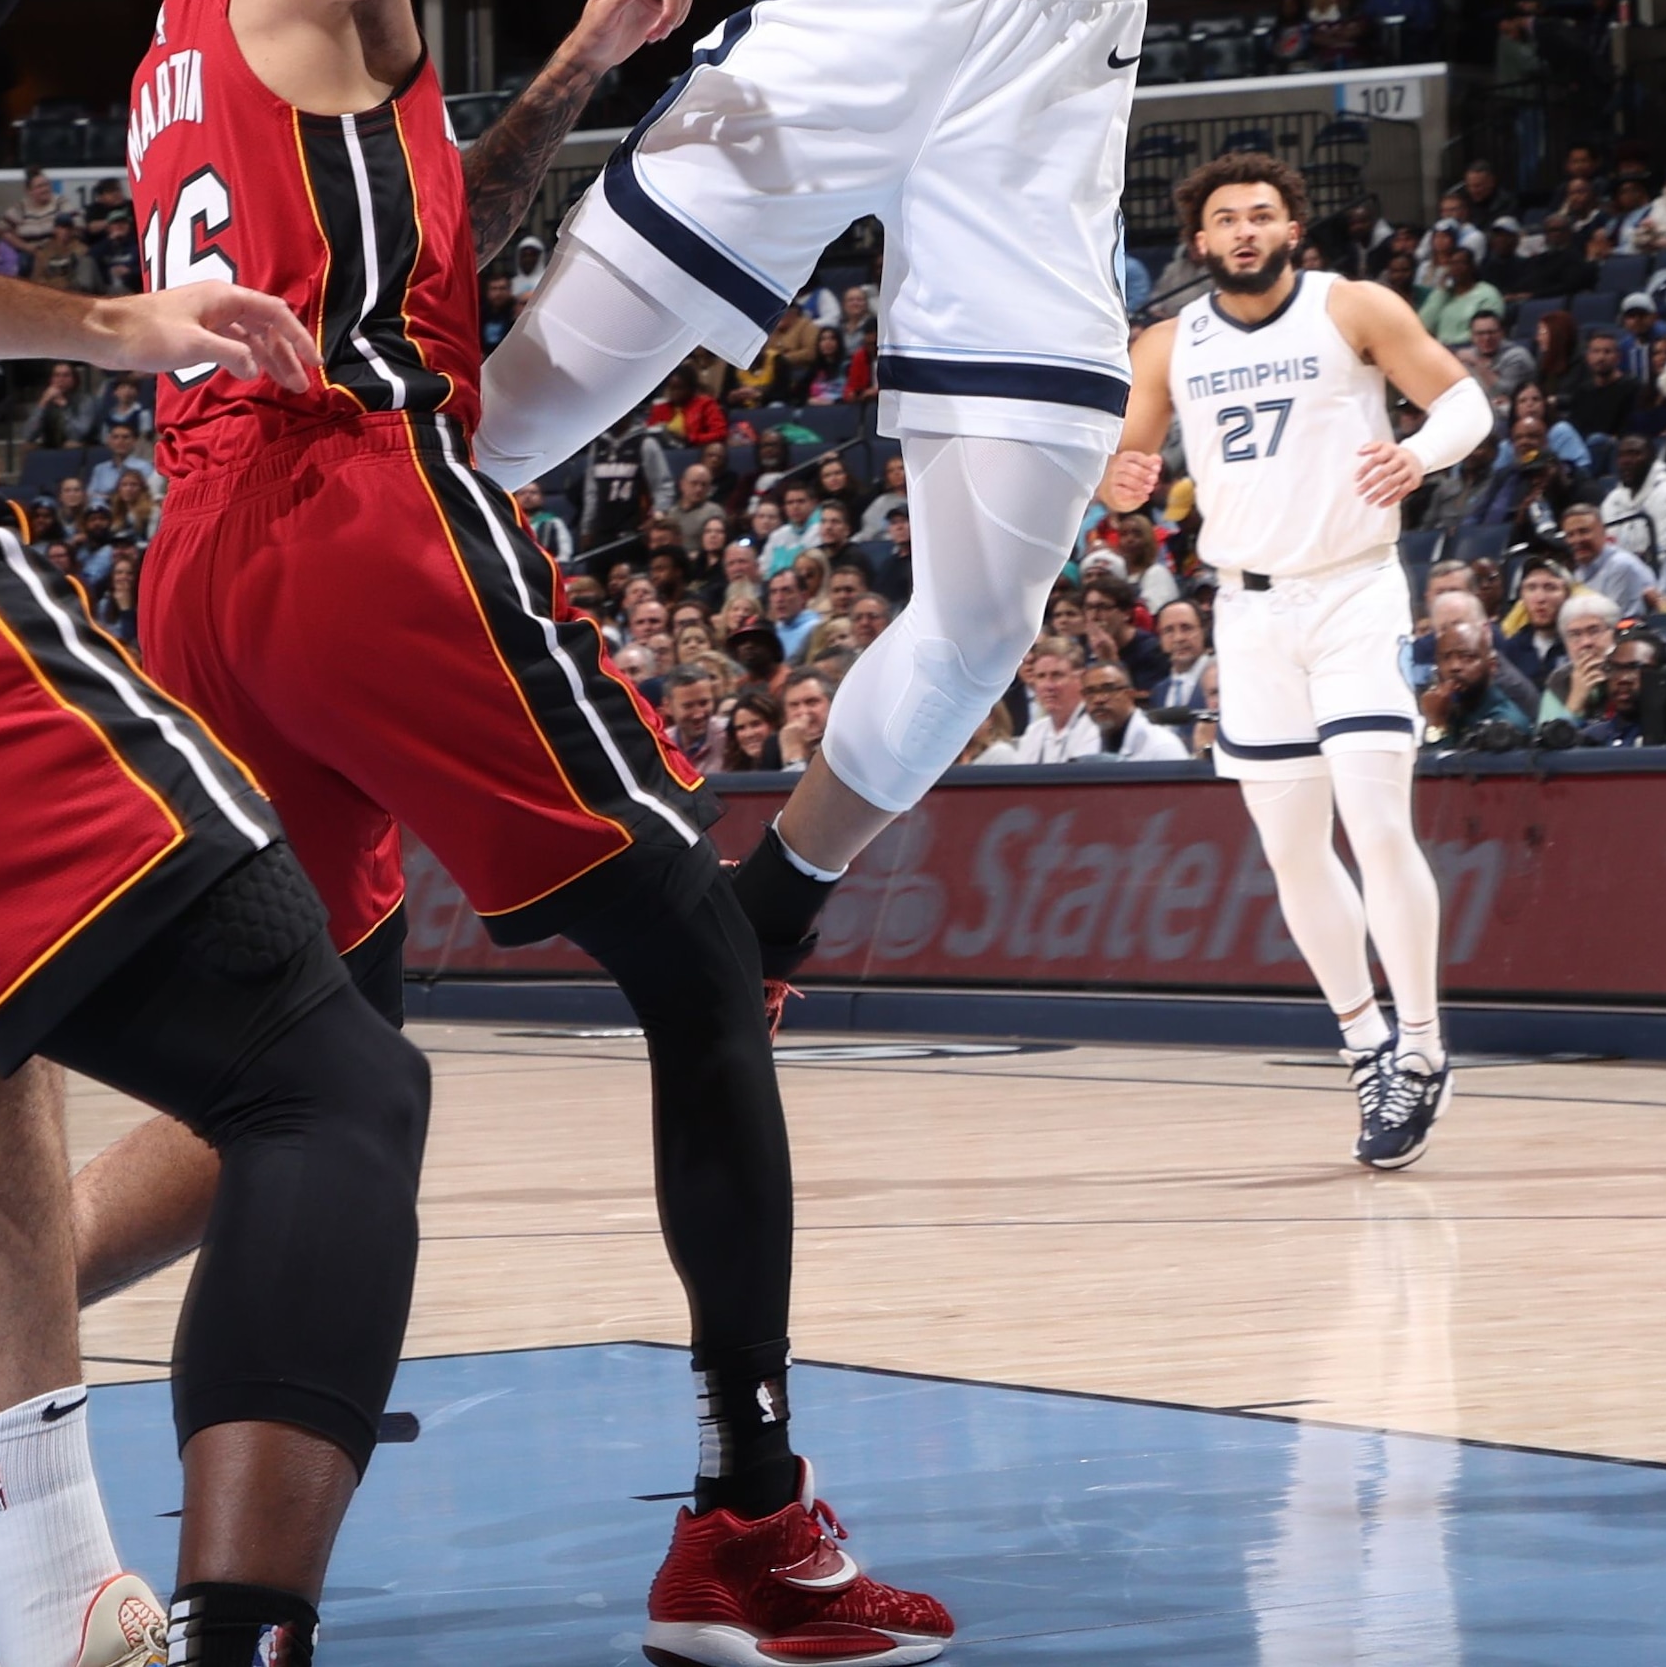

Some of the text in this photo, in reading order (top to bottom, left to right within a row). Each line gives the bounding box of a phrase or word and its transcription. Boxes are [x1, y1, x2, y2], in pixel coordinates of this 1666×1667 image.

[127, 48, 202, 182] MARTIN
[1361, 86, 1406, 114] 107
[143, 163, 237, 390] 16
[1186, 355, 1321, 401] MEMPHIS
[1216, 397, 1296, 464] 27
